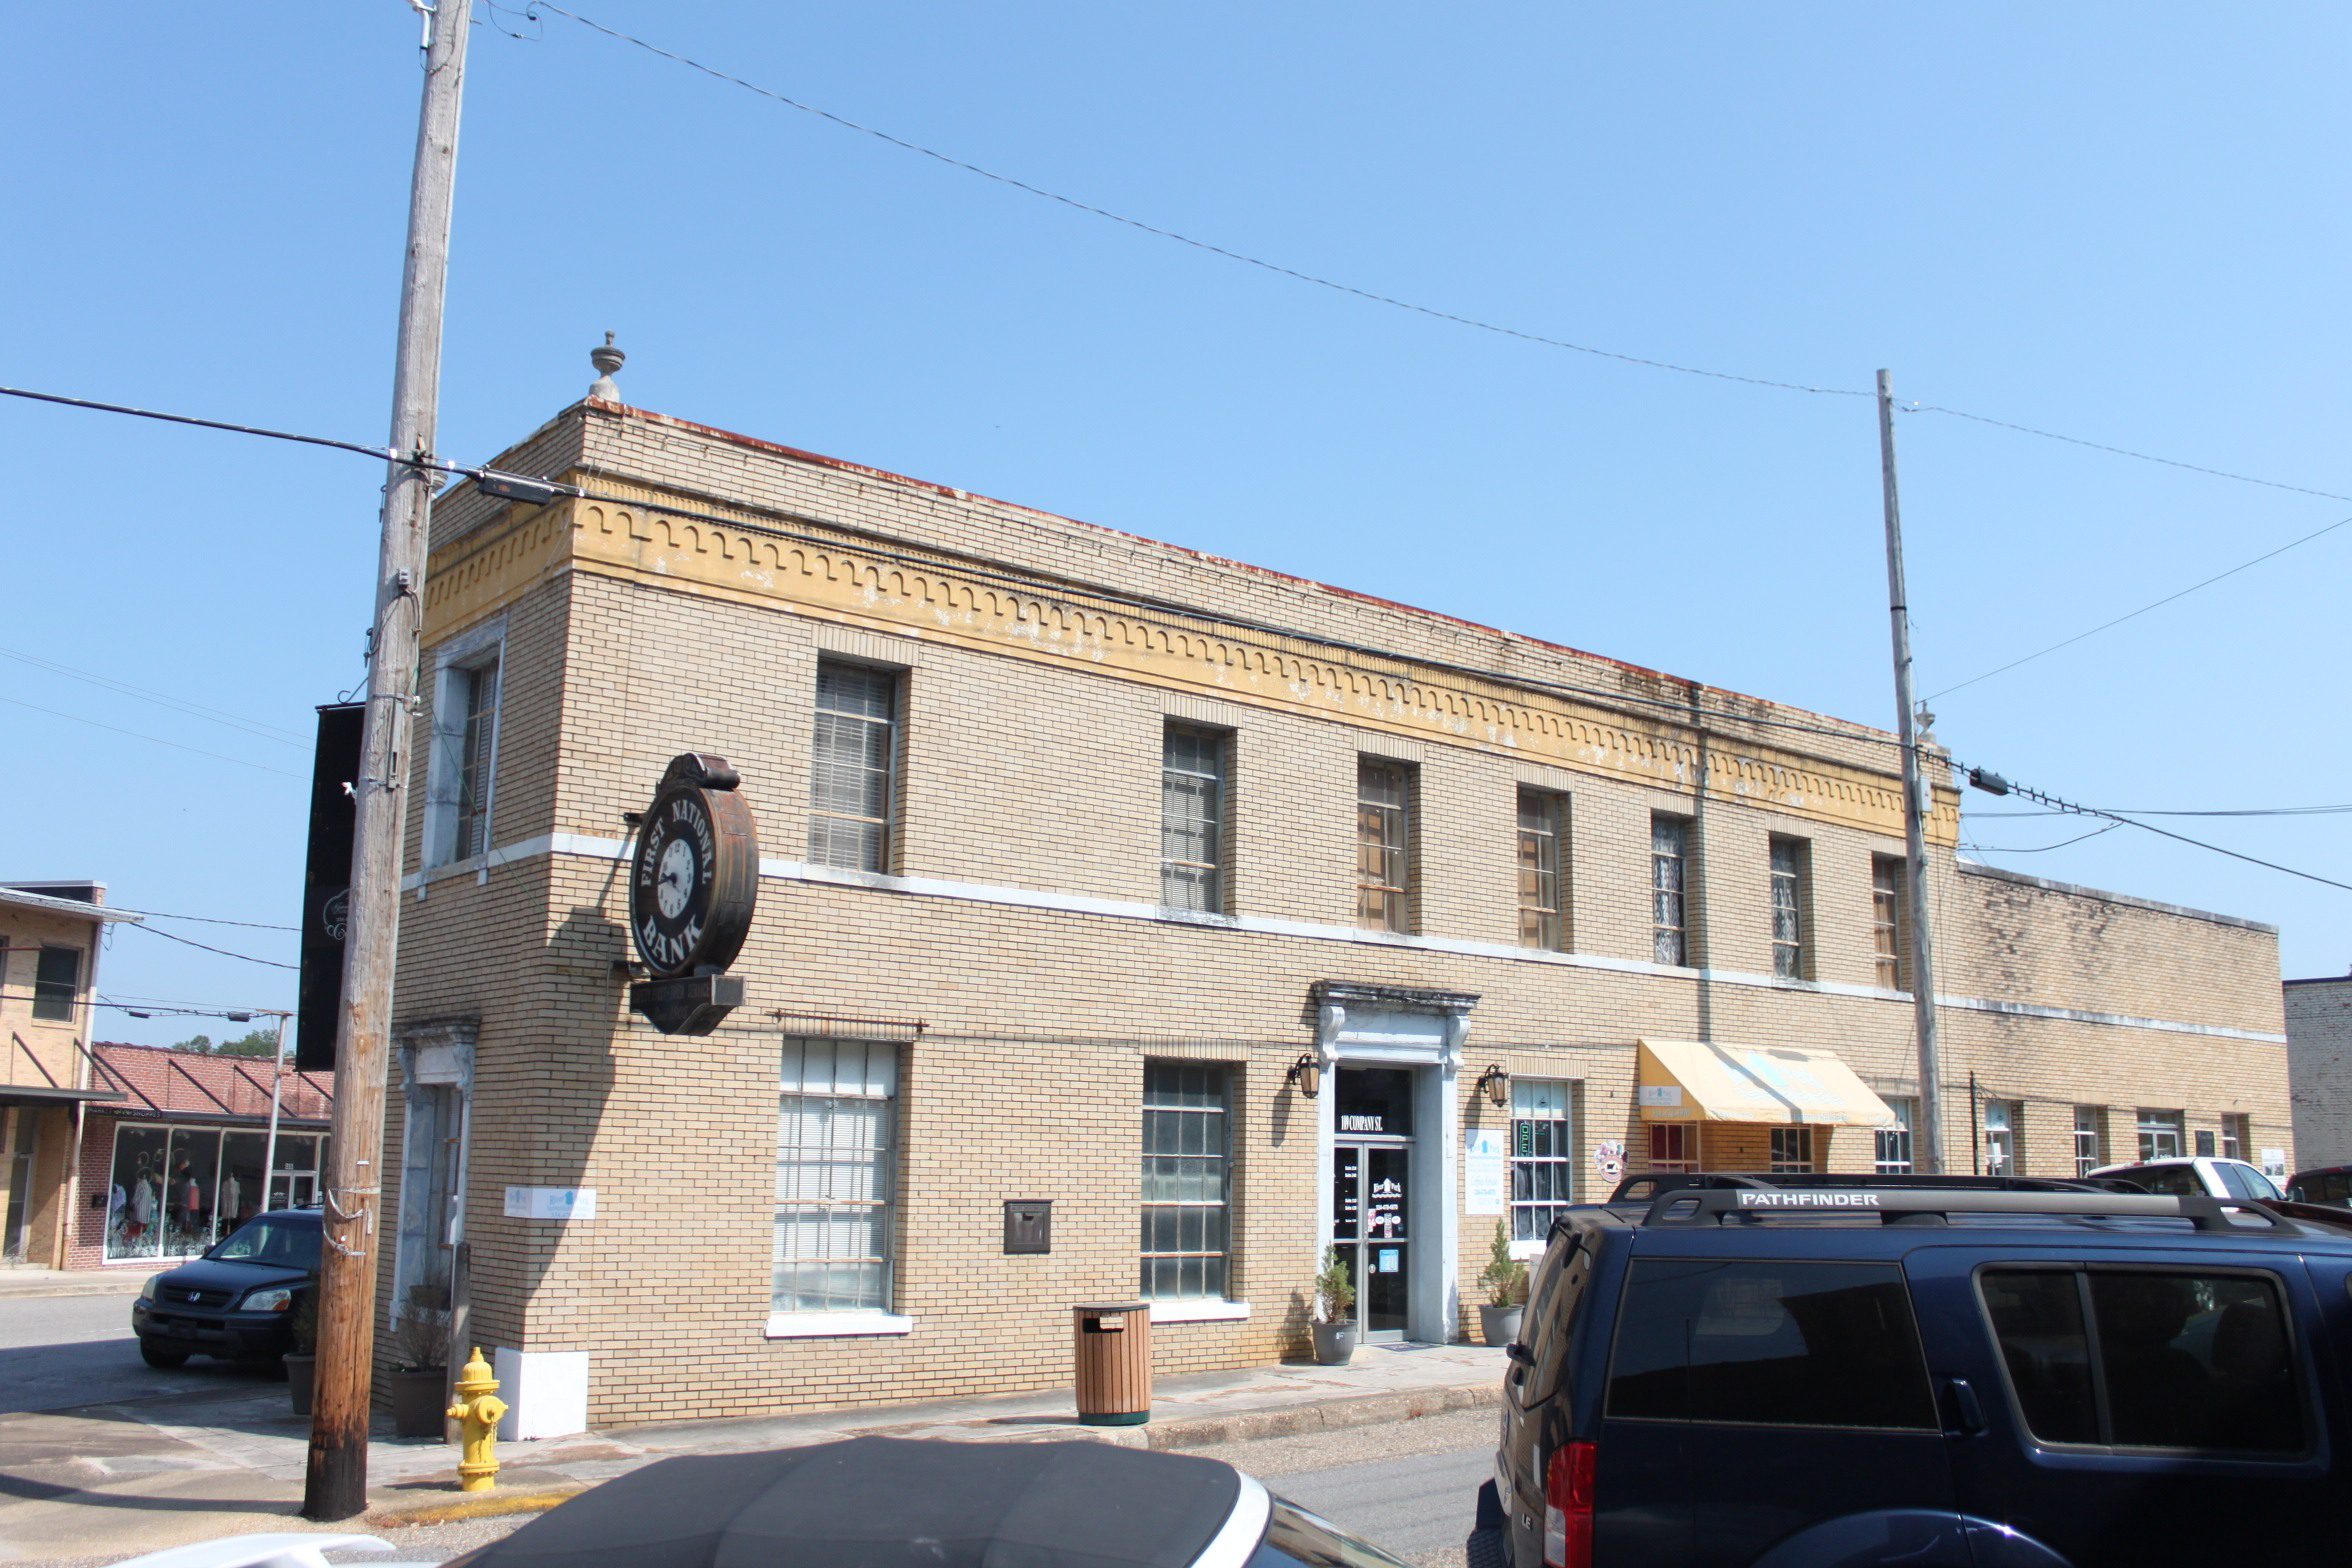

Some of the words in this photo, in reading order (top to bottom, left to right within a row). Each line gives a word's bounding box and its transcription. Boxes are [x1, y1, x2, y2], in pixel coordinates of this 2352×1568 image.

[641, 817, 665, 886] FIRST
[672, 799, 712, 884] NATIONAL
[643, 914, 703, 964] BANK
[1742, 1193, 1879, 1206] PATHFINDER
